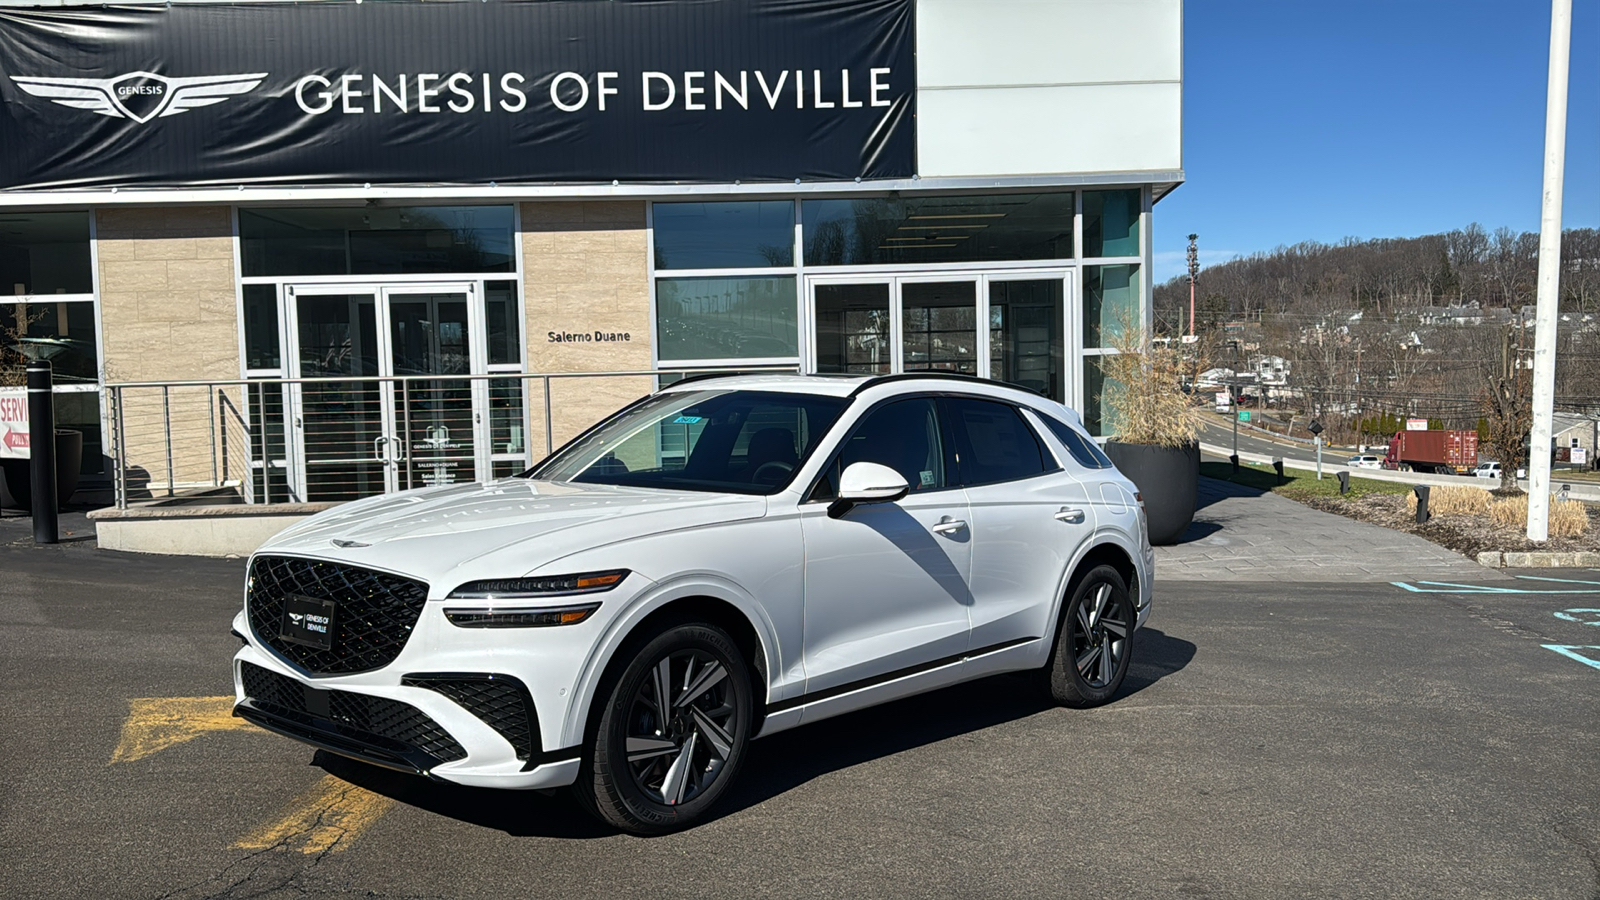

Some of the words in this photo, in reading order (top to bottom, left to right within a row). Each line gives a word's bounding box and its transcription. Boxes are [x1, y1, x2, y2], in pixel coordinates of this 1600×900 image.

[118, 85, 162, 95] GENESIS
[294, 72, 527, 115] GENESIS
[550, 71, 619, 112] OF
[642, 67, 891, 111] DENVILLE
[547, 331, 592, 343] Salerno
[594, 331, 631, 342] Duane
[0, 397, 28, 422] SERVI
[306, 614, 323, 623] GENESIS
[307, 623, 327, 633] DENVILLE
